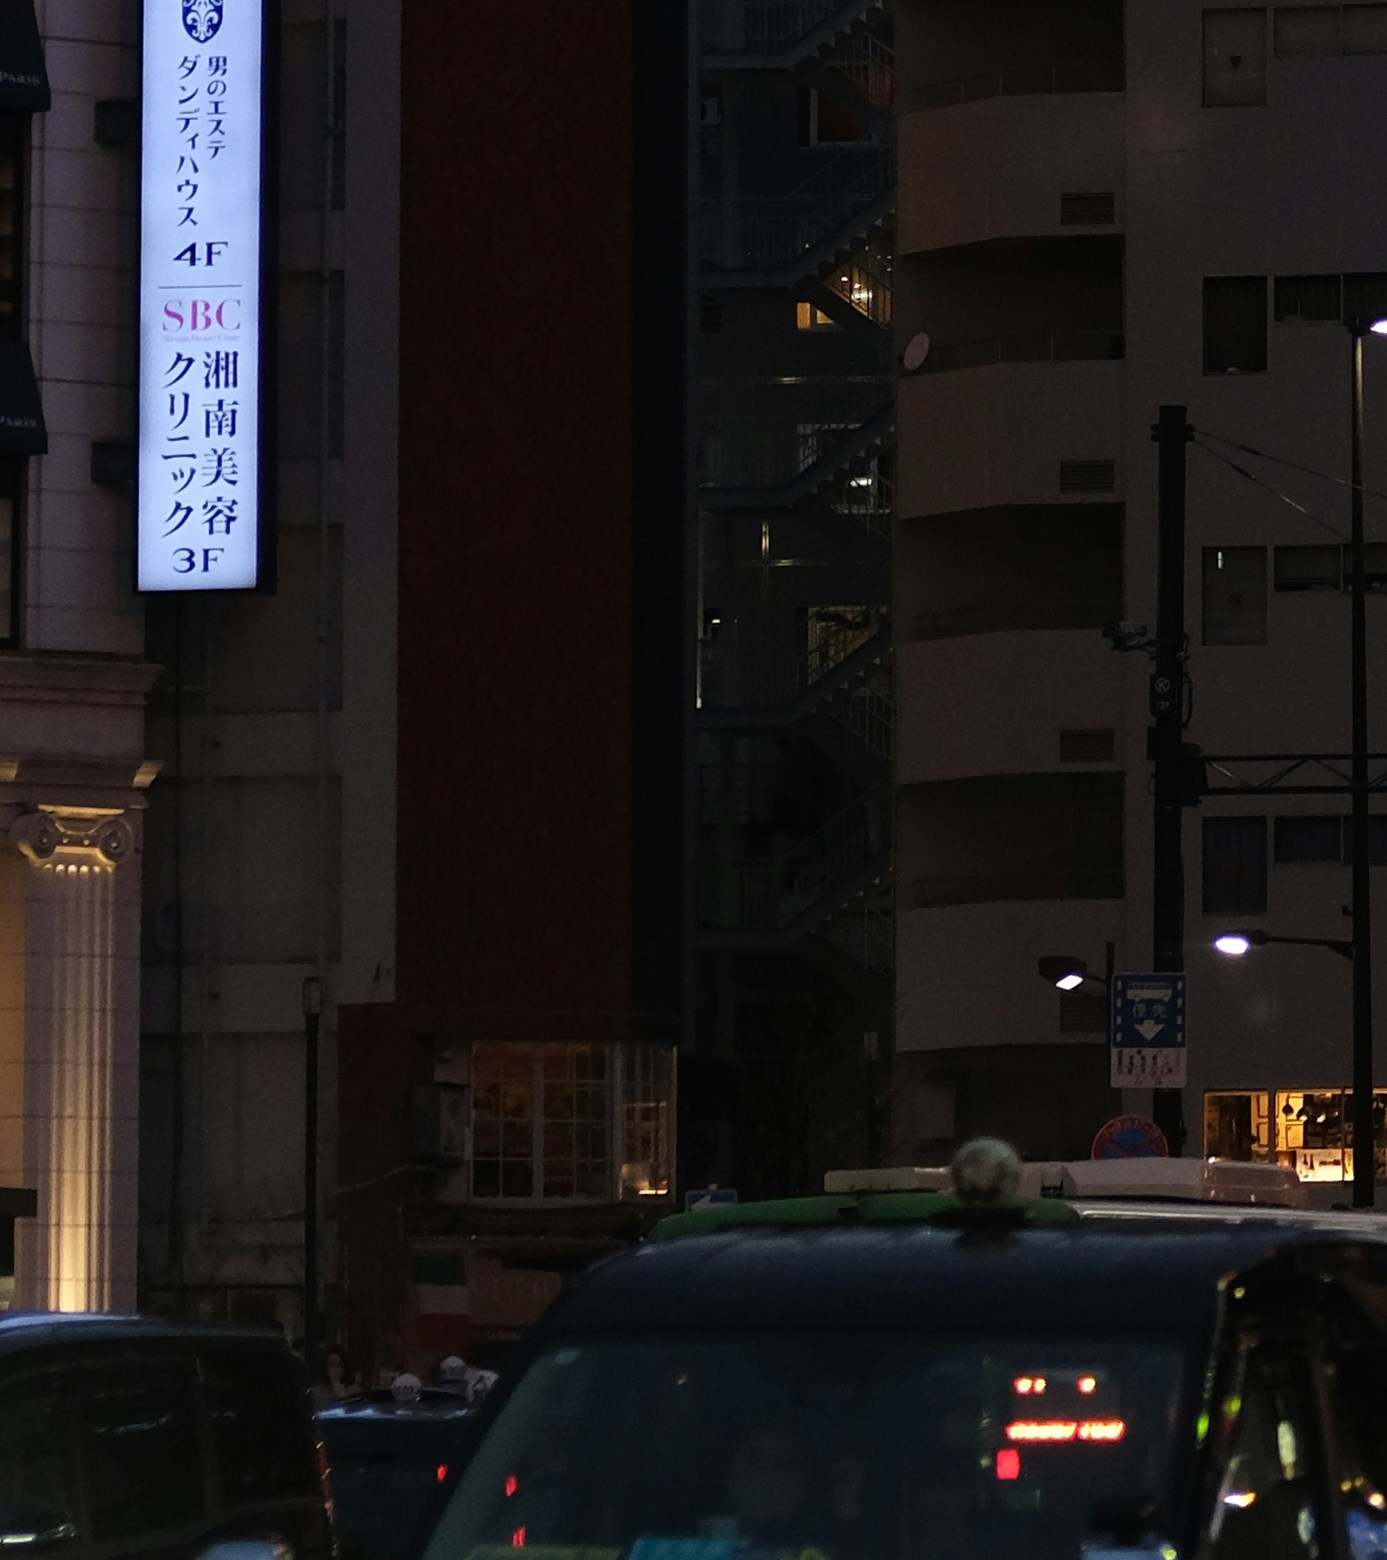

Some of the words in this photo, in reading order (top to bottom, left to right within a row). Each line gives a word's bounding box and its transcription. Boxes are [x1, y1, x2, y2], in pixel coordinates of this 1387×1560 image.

[175, 55, 201, 228] ダンディハウス
[206, 55, 228, 160] 男のエステ
[173, 241, 229, 267] 4F
[162, 298, 241, 332] SBC
[161, 350, 198, 539] クリニック
[201, 350, 239, 536] 湘南美容
[172, 547, 225, 574] 3F
